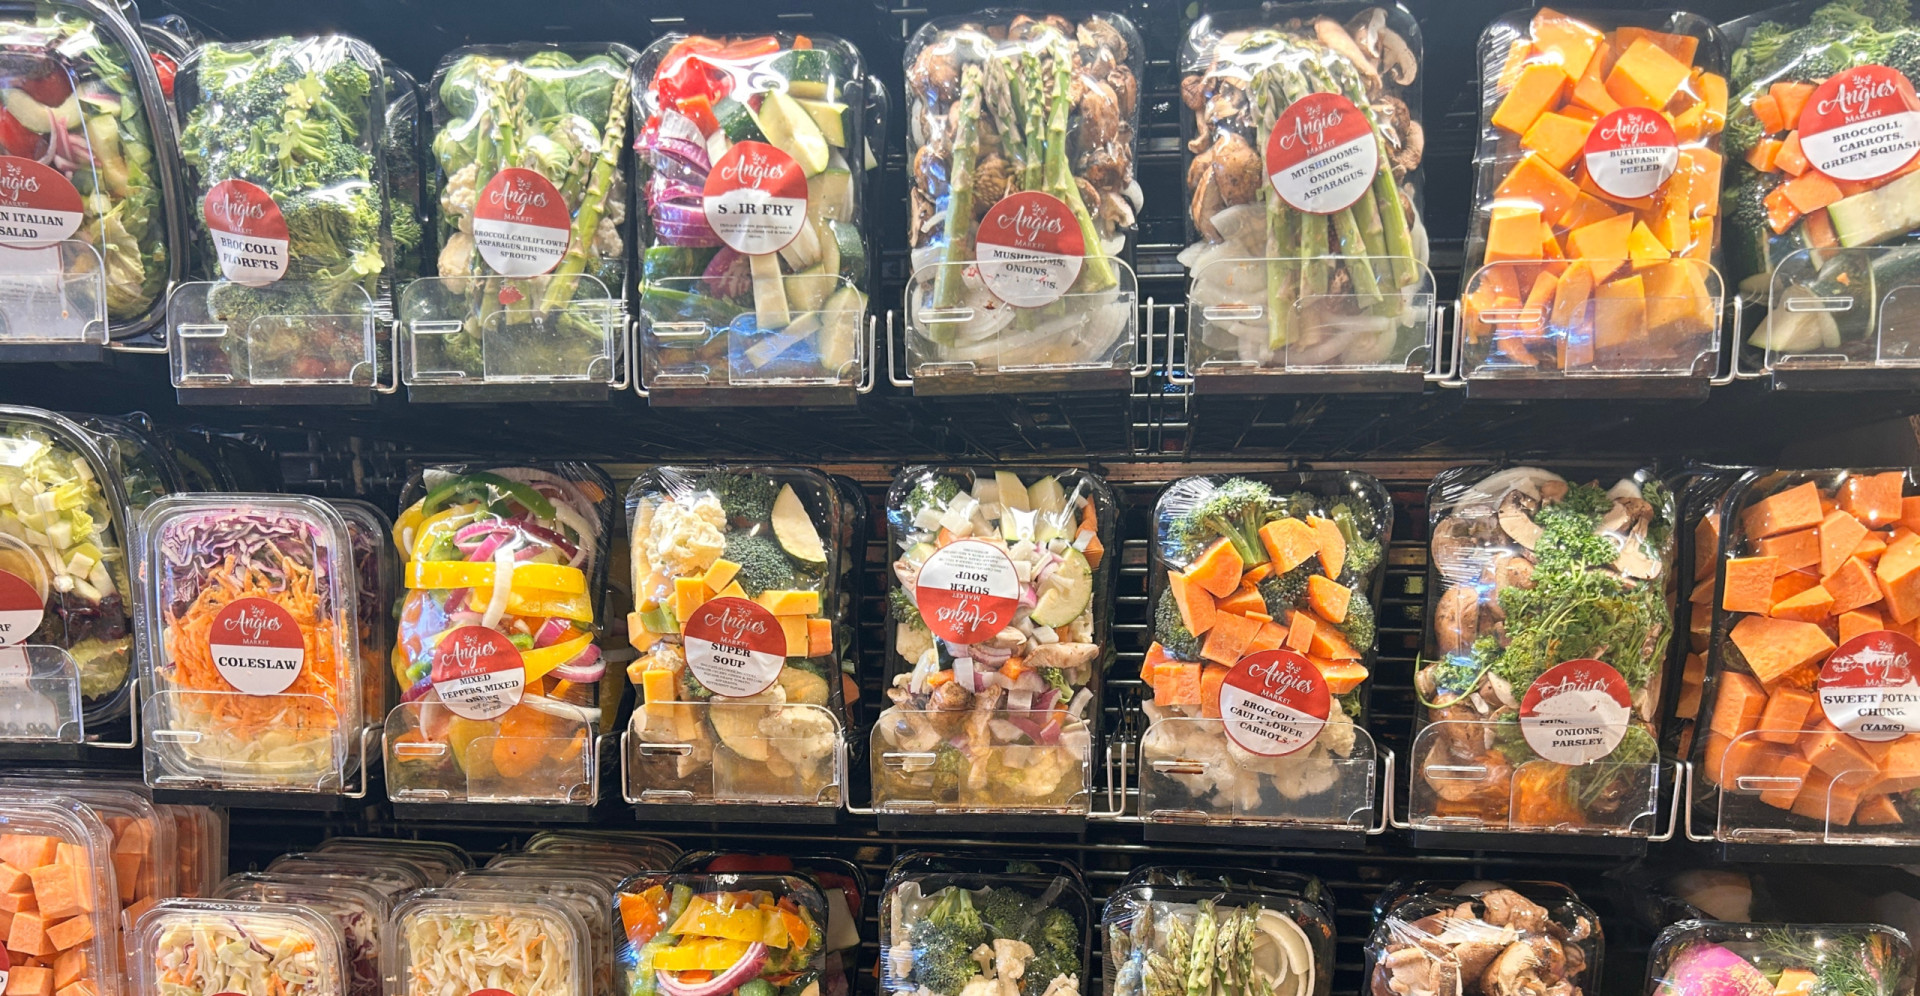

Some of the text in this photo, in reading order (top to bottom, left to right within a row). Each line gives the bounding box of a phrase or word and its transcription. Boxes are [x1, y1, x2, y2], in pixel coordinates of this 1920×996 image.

[1817, 79, 1897, 115] Angies
[1845, 109, 1882, 123] MARKET
[1280, 108, 1343, 150] Angies
[1601, 118, 1659, 144] Angies
[1610, 148, 1667, 158] BUTTERNUT
[1821, 151, 1867, 170] GREEN
[1620, 156, 1659, 166] SQUASH
[721, 154, 786, 189] Angies
[1621, 164, 1660, 174] PEELED
[0, 168, 40, 201] ngies
[490, 181, 548, 215] Angies
[213, 193, 265, 227] Angies
[718, 203, 794, 216] SIR FRY
[13, 212, 63, 226] ITALIAN
[998, 205, 1064, 241] Angies
[0, 226, 38, 238] SALAD
[221, 237, 278, 255] BROCCOLI
[223, 253, 279, 270] FLORETS
[500, 251, 537, 261] SPROUTS
[955, 571, 988, 582] SOUP
[950, 583, 990, 595] SUPER
[704, 607, 768, 639] Angies
[935, 599, 997, 632] Angies
[224, 609, 282, 639] Angies
[442, 641, 497, 669] Angies
[711, 643, 751, 657] SUPER
[219, 656, 297, 670] COLESLAW
[713, 655, 745, 668] SOUP
[459, 674, 491, 685] MIXED
[1248, 660, 1314, 695] Angies
[1261, 689, 1291, 704] MARKET
[1824, 694, 1920, 704] SWEET POTAT
[1861, 724, 1905, 732] (YAMS)
